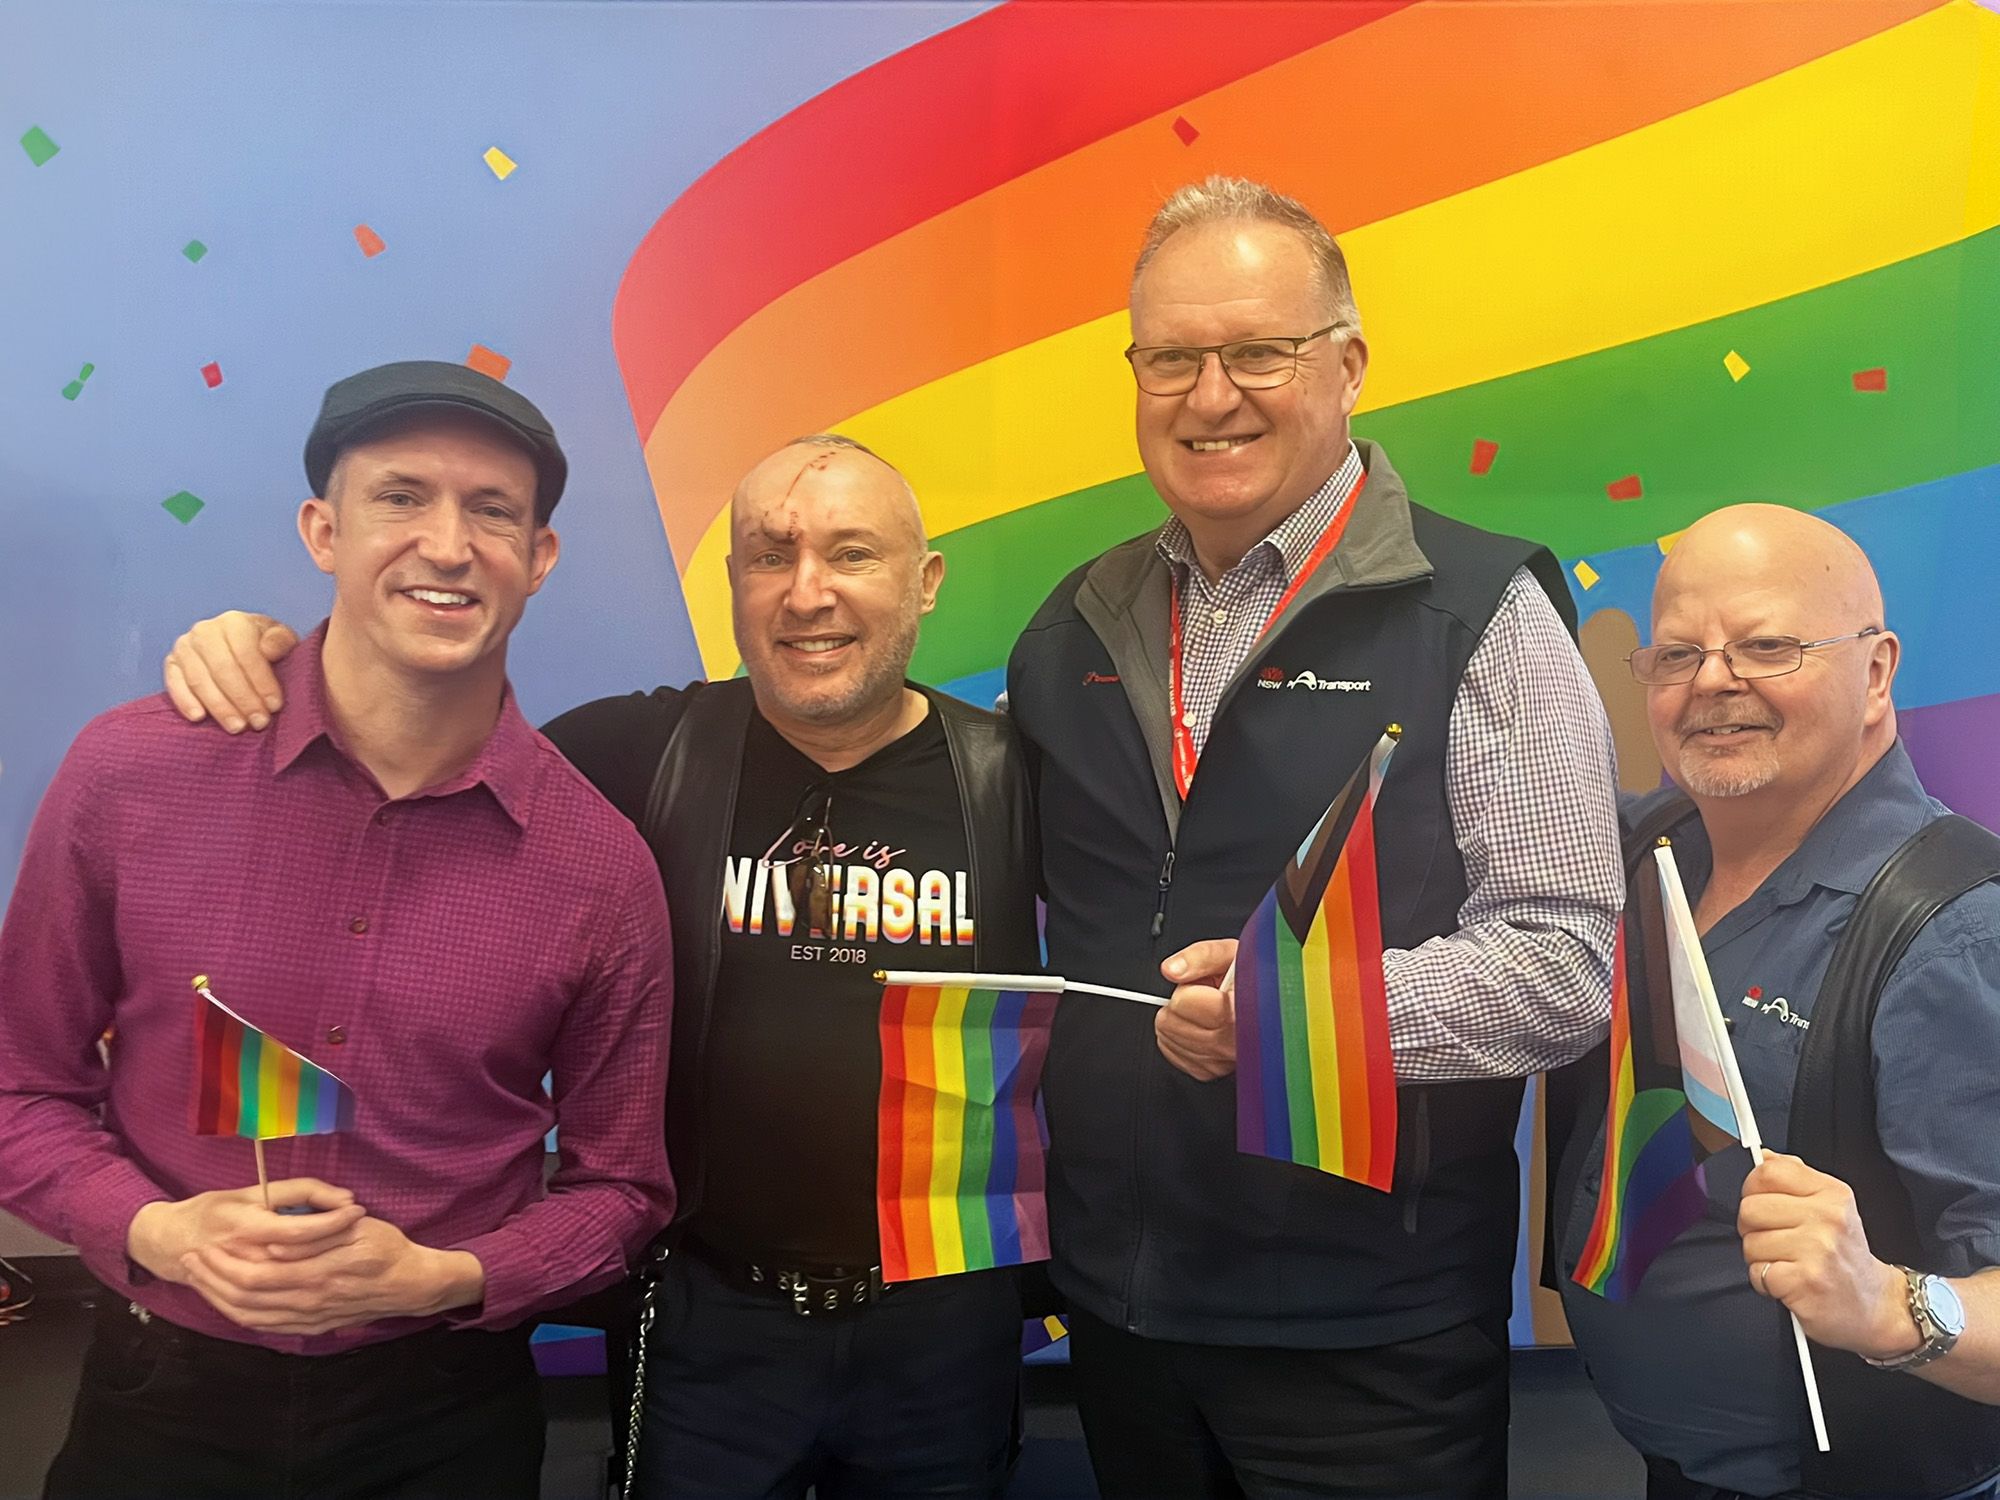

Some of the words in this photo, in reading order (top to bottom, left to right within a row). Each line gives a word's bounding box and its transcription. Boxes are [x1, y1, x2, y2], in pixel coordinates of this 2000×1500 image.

[1257, 679, 1282, 690] NSW
[1317, 680, 1371, 692] Transport
[862, 840, 907, 869] is
[791, 945, 825, 961] EST
[829, 947, 867, 964] 2018
